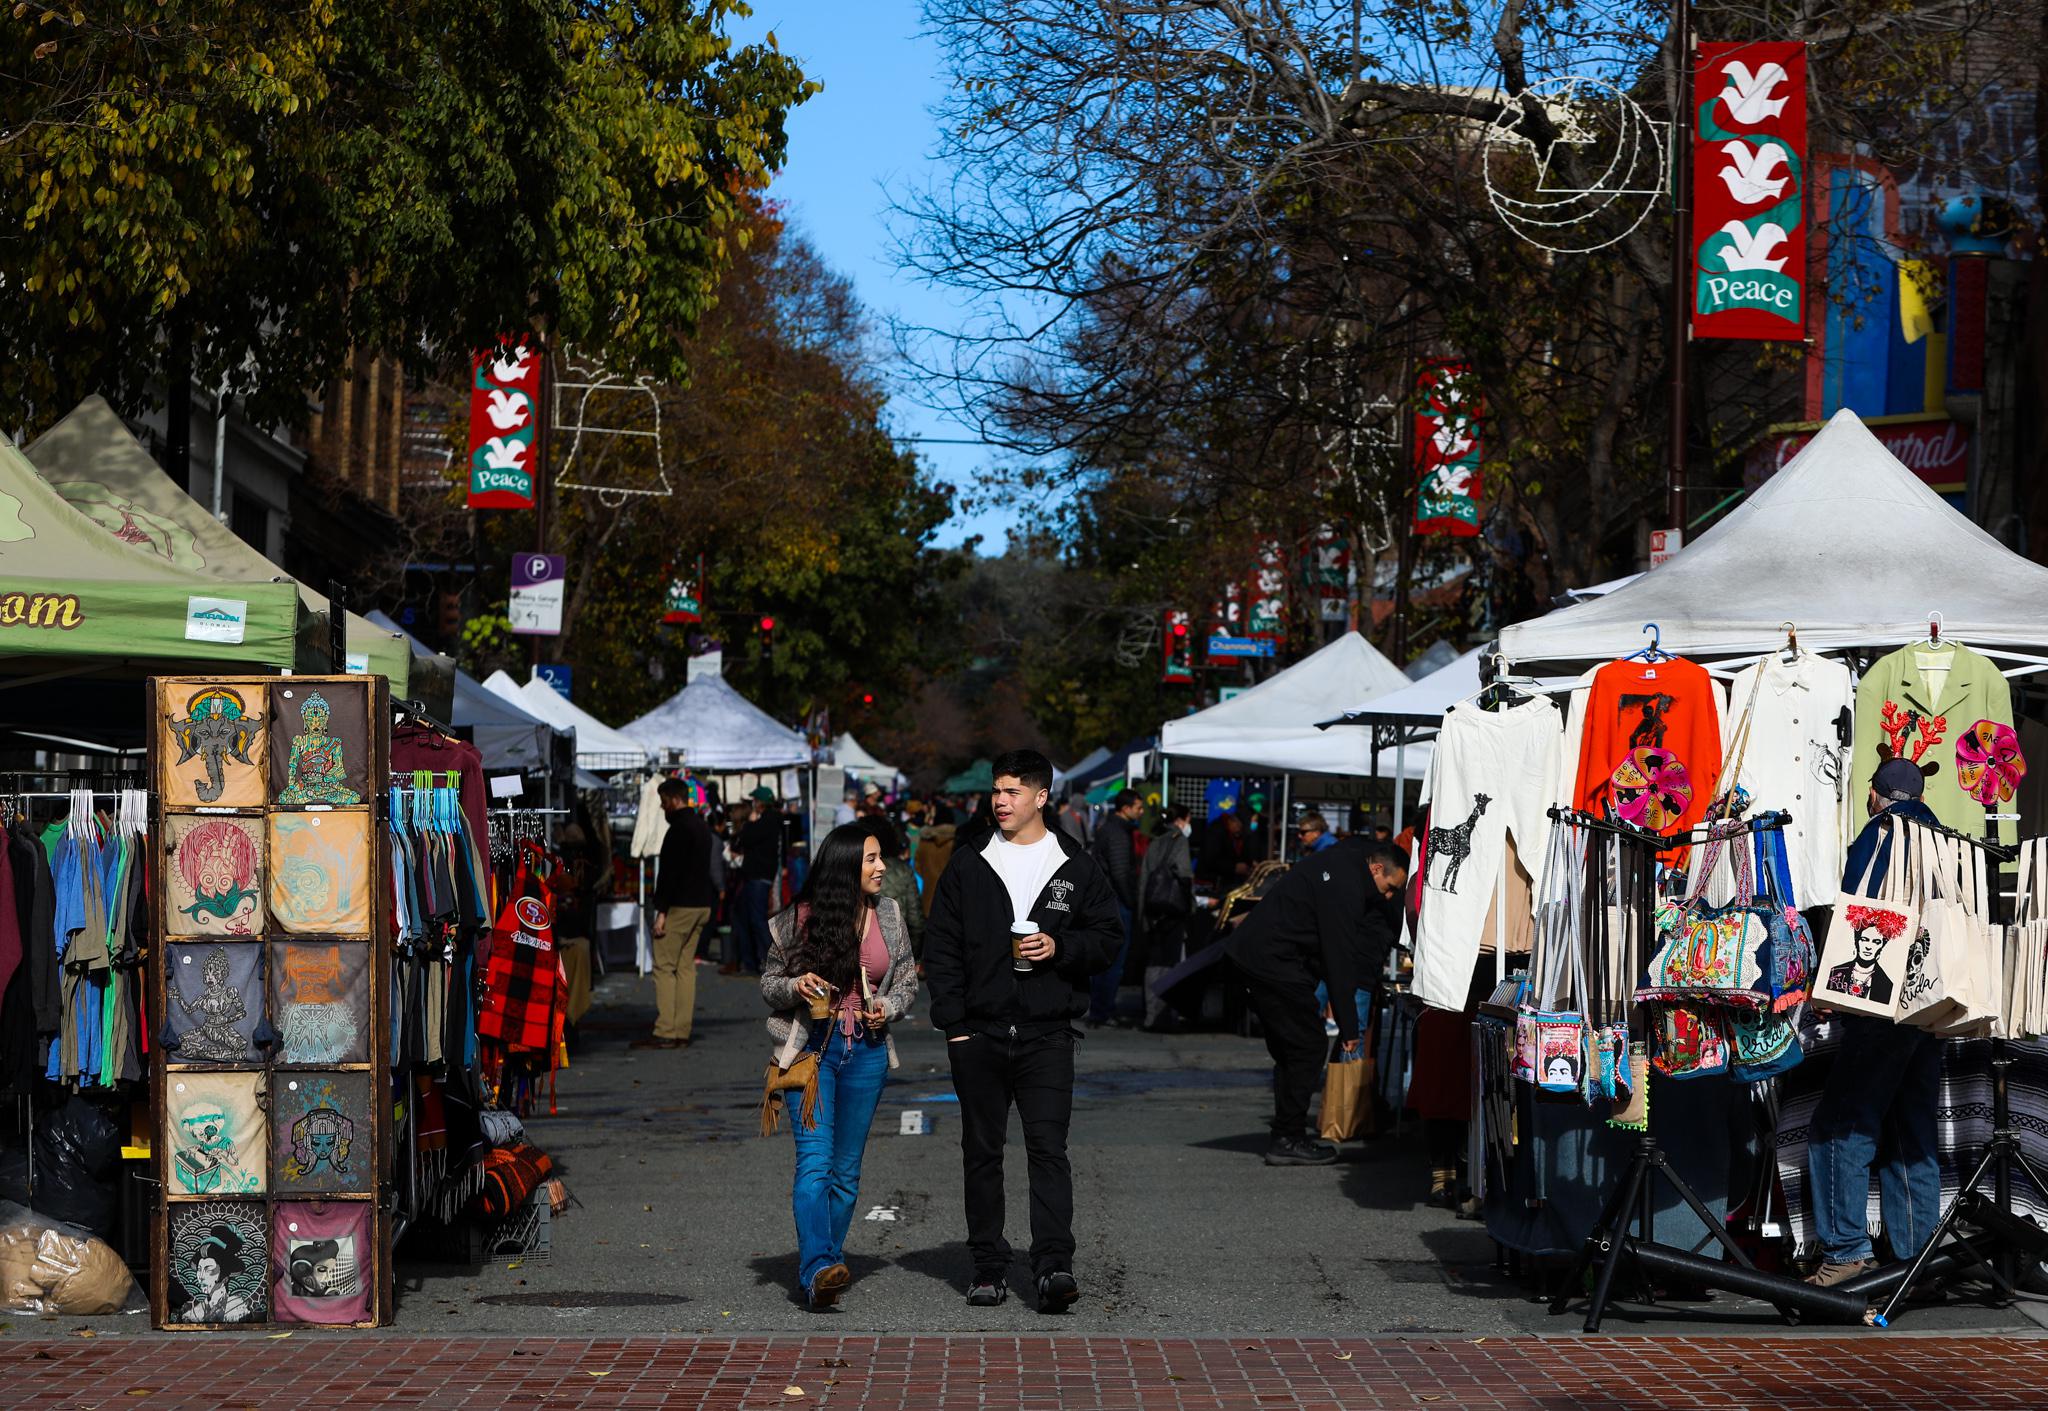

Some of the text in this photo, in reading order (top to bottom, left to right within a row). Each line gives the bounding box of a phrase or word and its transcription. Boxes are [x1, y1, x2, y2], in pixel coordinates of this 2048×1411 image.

[1706, 277, 1793, 308] Peace
[478, 470, 529, 491] Peace
[532, 559, 546, 577] P
[1049, 879, 1074, 891] AKLAND
[1045, 900, 1070, 911] AIDERS
